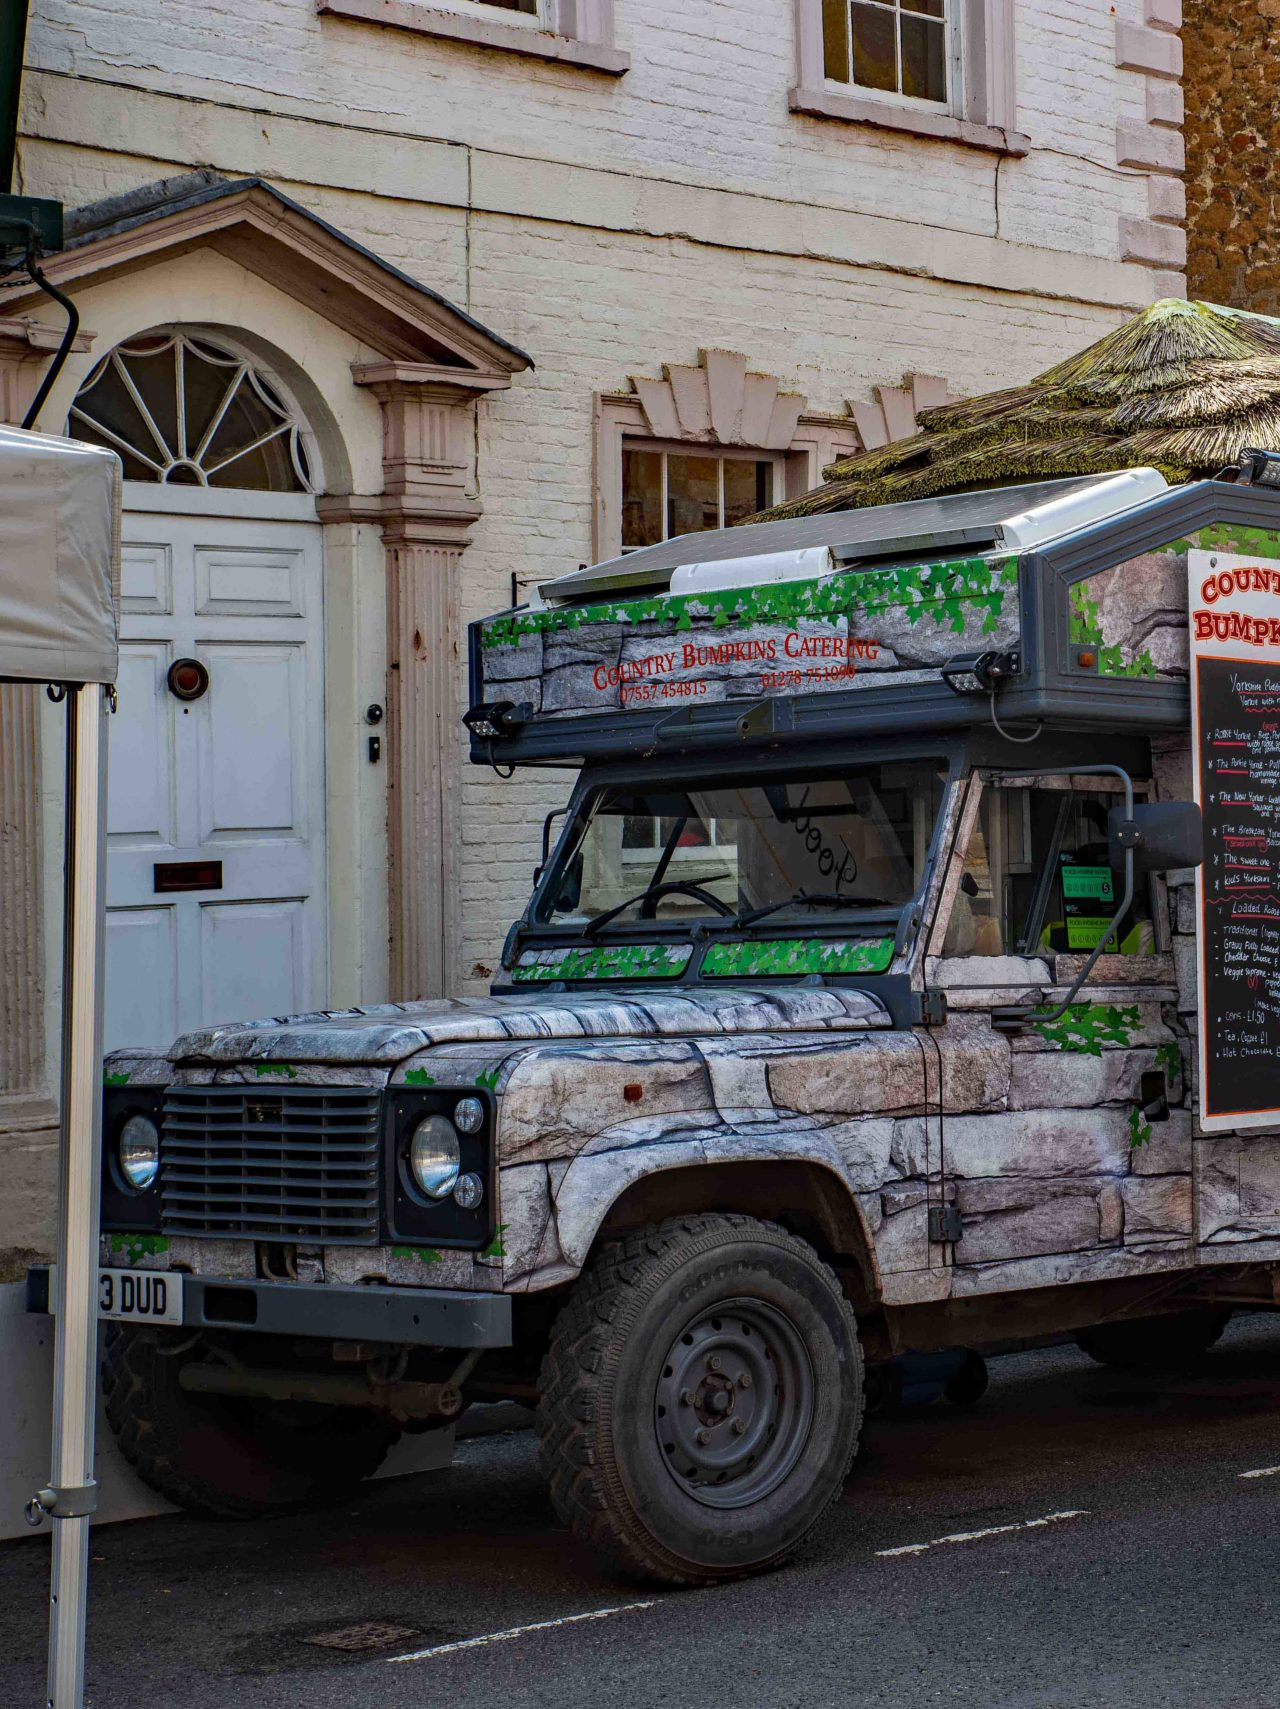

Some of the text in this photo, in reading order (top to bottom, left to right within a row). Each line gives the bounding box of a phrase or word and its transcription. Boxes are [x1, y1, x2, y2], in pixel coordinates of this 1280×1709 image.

[593, 632, 879, 691] COUNTRY BUMPKINS CATERING
[761, 669, 801, 688] 01278
[620, 681, 707, 703] 07557 454815
[1217, 759, 1228, 768] The
[1219, 791, 1231, 801] The
[1222, 825, 1235, 834] The
[1224, 853, 1237, 863] The
[1233, 902, 1260, 913] Loaded
[1247, 1010, 1265, 1025] £1.50
[1222, 1047, 1237, 1058] Hot
[1240, 1047, 1274, 1058] Chocolate
[121, 1275, 166, 1315] DUD
